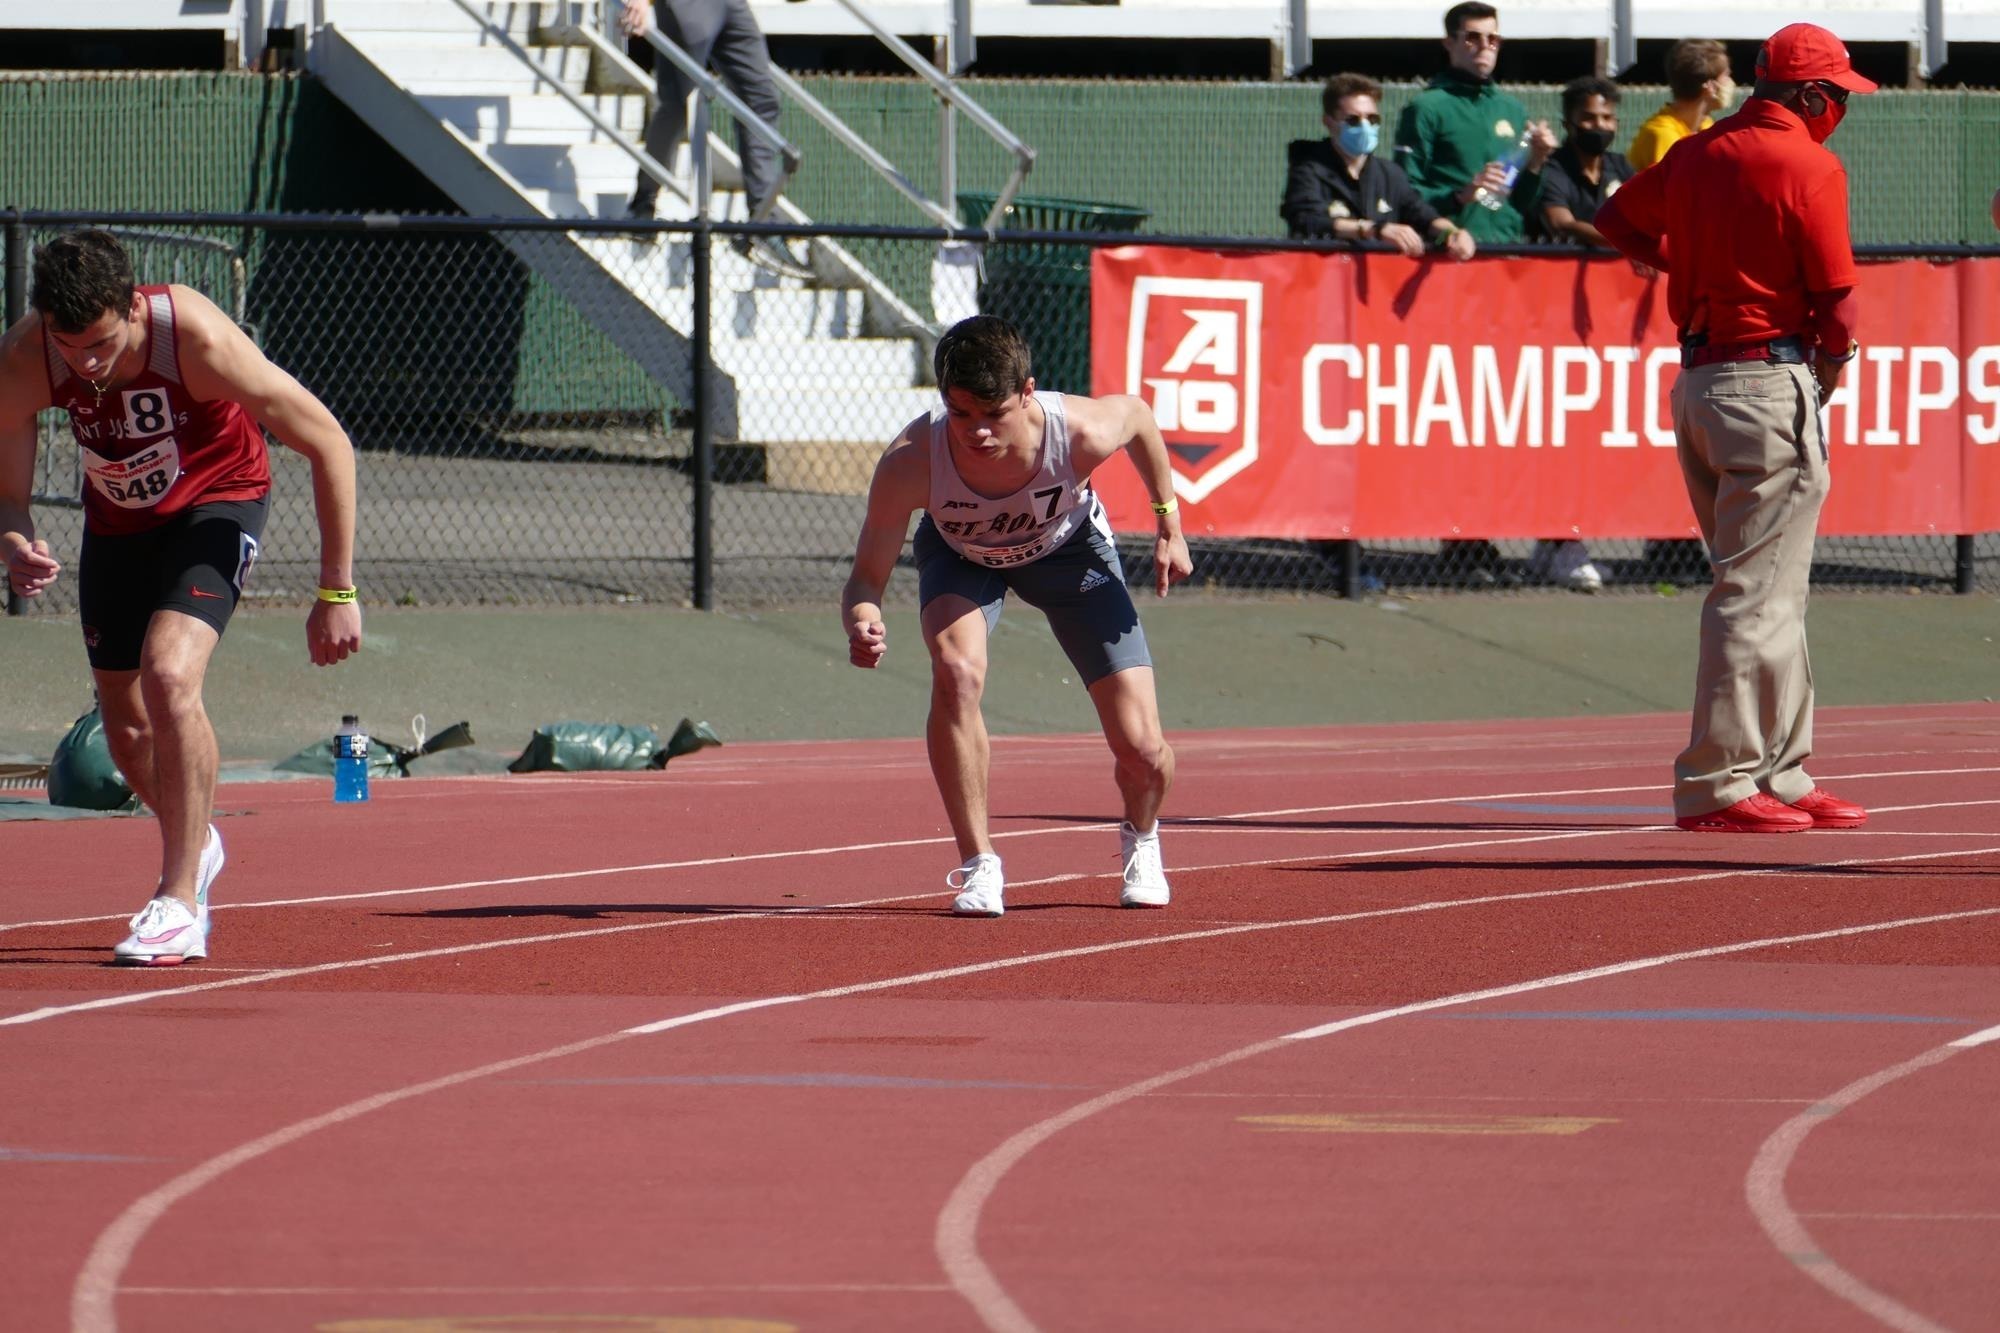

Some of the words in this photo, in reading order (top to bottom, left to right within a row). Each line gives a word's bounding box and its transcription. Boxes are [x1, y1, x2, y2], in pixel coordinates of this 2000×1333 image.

[1302, 342, 2000, 448] CHAMPIOHIPS
[130, 392, 166, 434] 8
[102, 469, 169, 502] 548
[1033, 485, 1064, 520] 7
[982, 544, 1044, 567] 530
[1080, 575, 1111, 593] adidas
